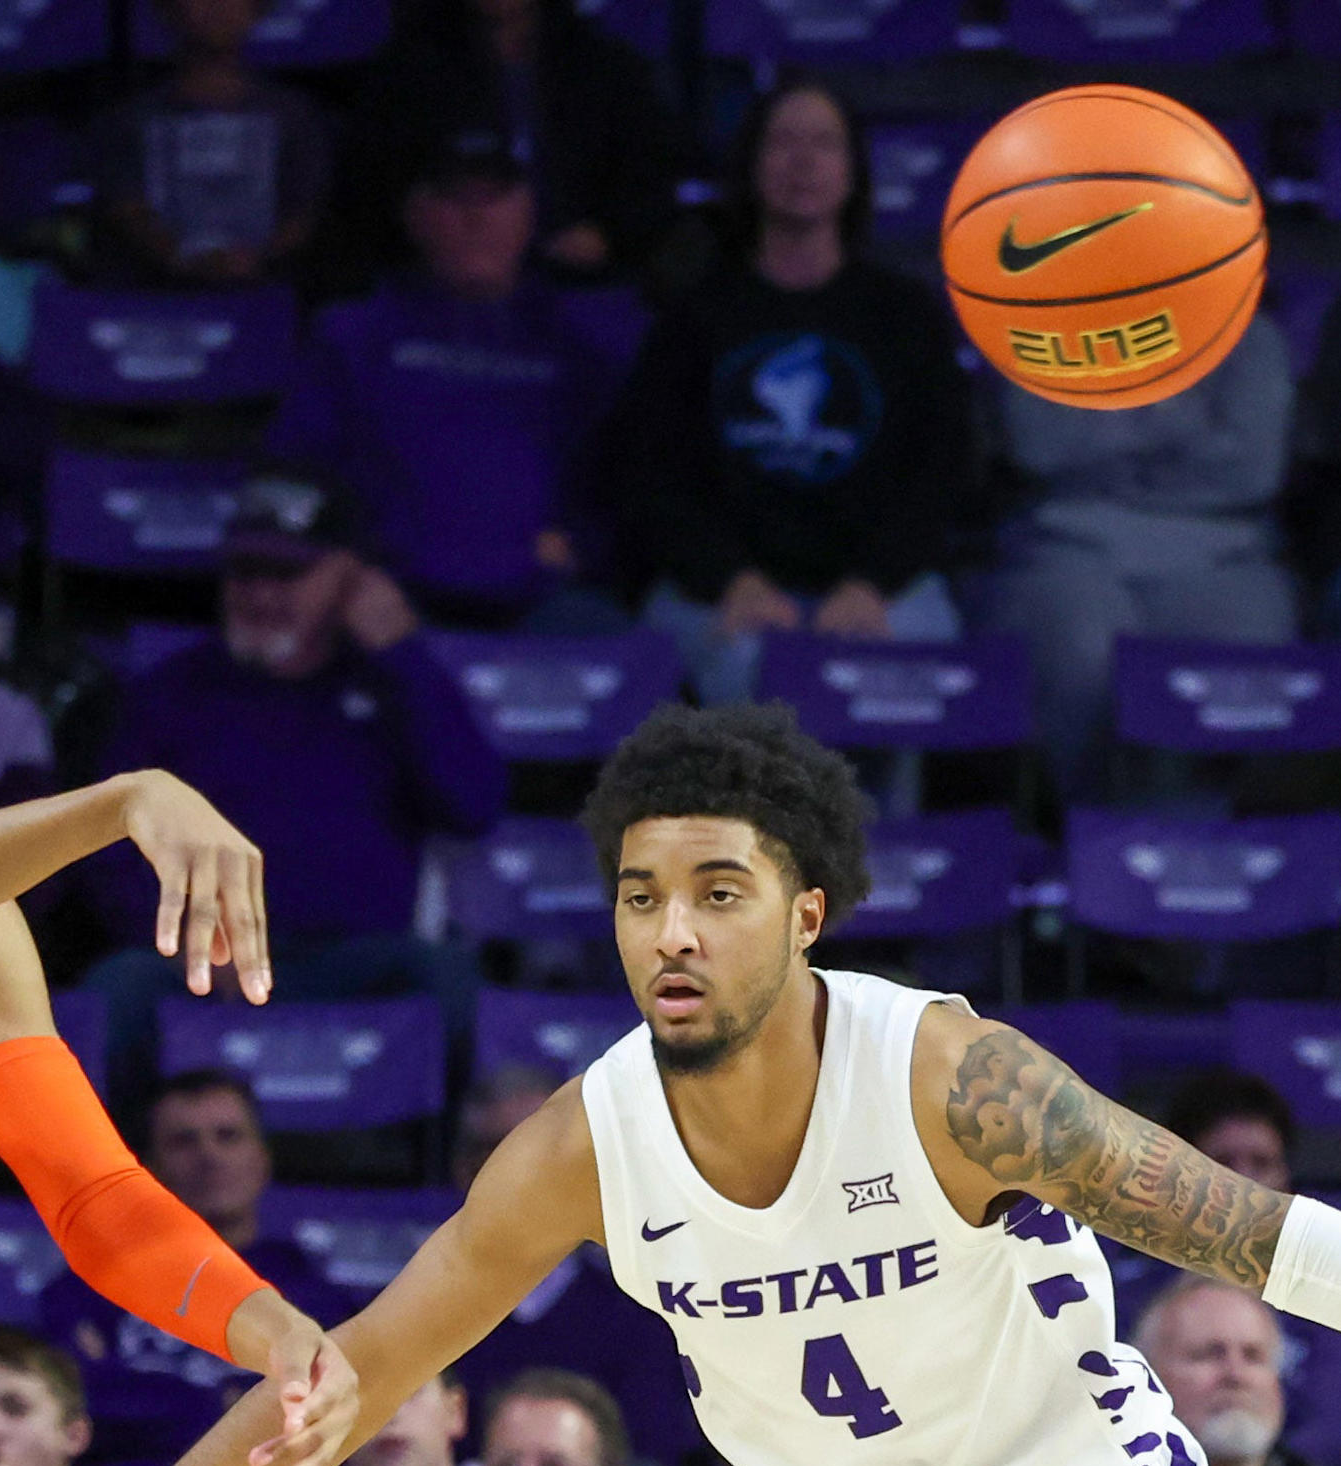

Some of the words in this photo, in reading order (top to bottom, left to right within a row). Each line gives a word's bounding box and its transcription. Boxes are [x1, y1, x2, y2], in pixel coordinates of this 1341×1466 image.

[1009, 309, 1180, 375] ELITE
[842, 1172, 900, 1214] XII
[655, 1239, 939, 1319] K-STATE
[801, 1333, 902, 1440] 4
